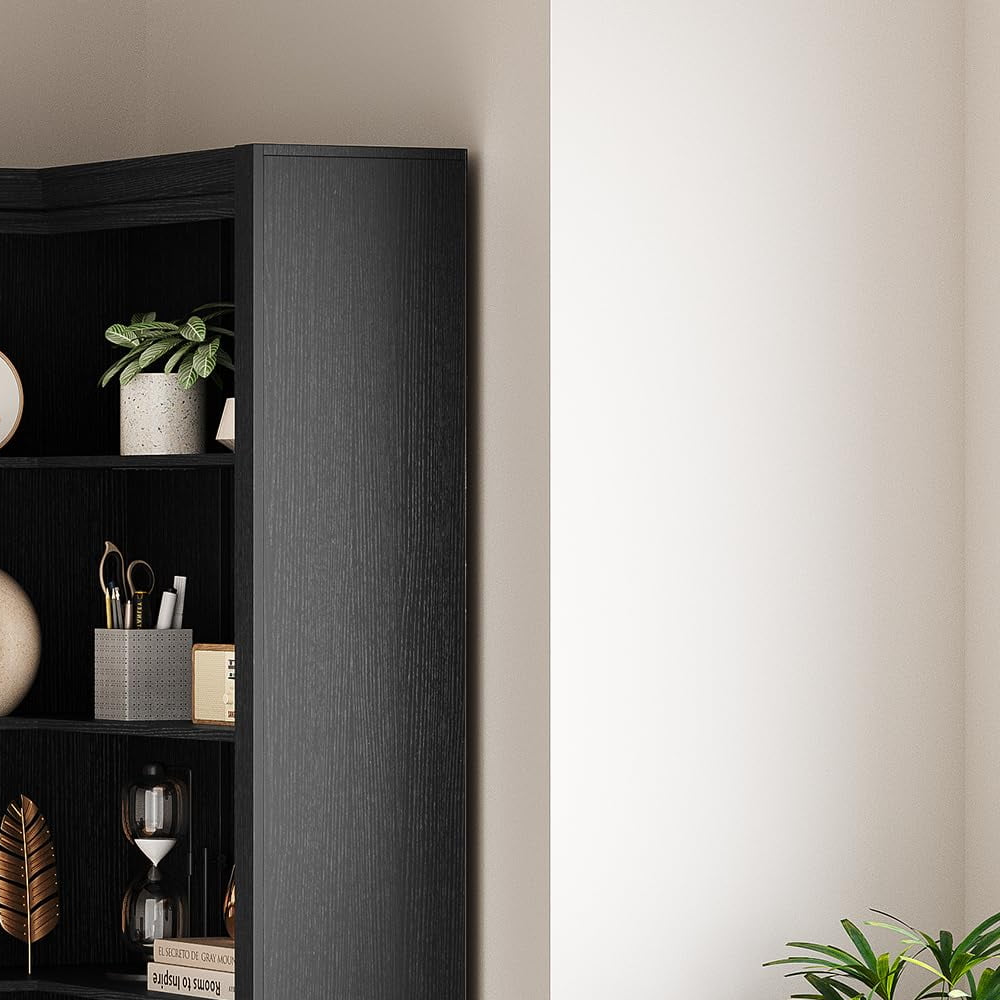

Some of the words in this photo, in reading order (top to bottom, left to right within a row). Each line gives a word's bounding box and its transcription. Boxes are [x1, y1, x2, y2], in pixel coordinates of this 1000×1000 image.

[158, 946, 164, 957] EL
[165, 948, 190, 960] SECRETO
[191, 951, 199, 960] DE
[201, 952, 216, 963] GRAY
[153, 970, 180, 990] Inspire
[182, 976, 191, 991] to
[193, 978, 221, 996] Rooms
